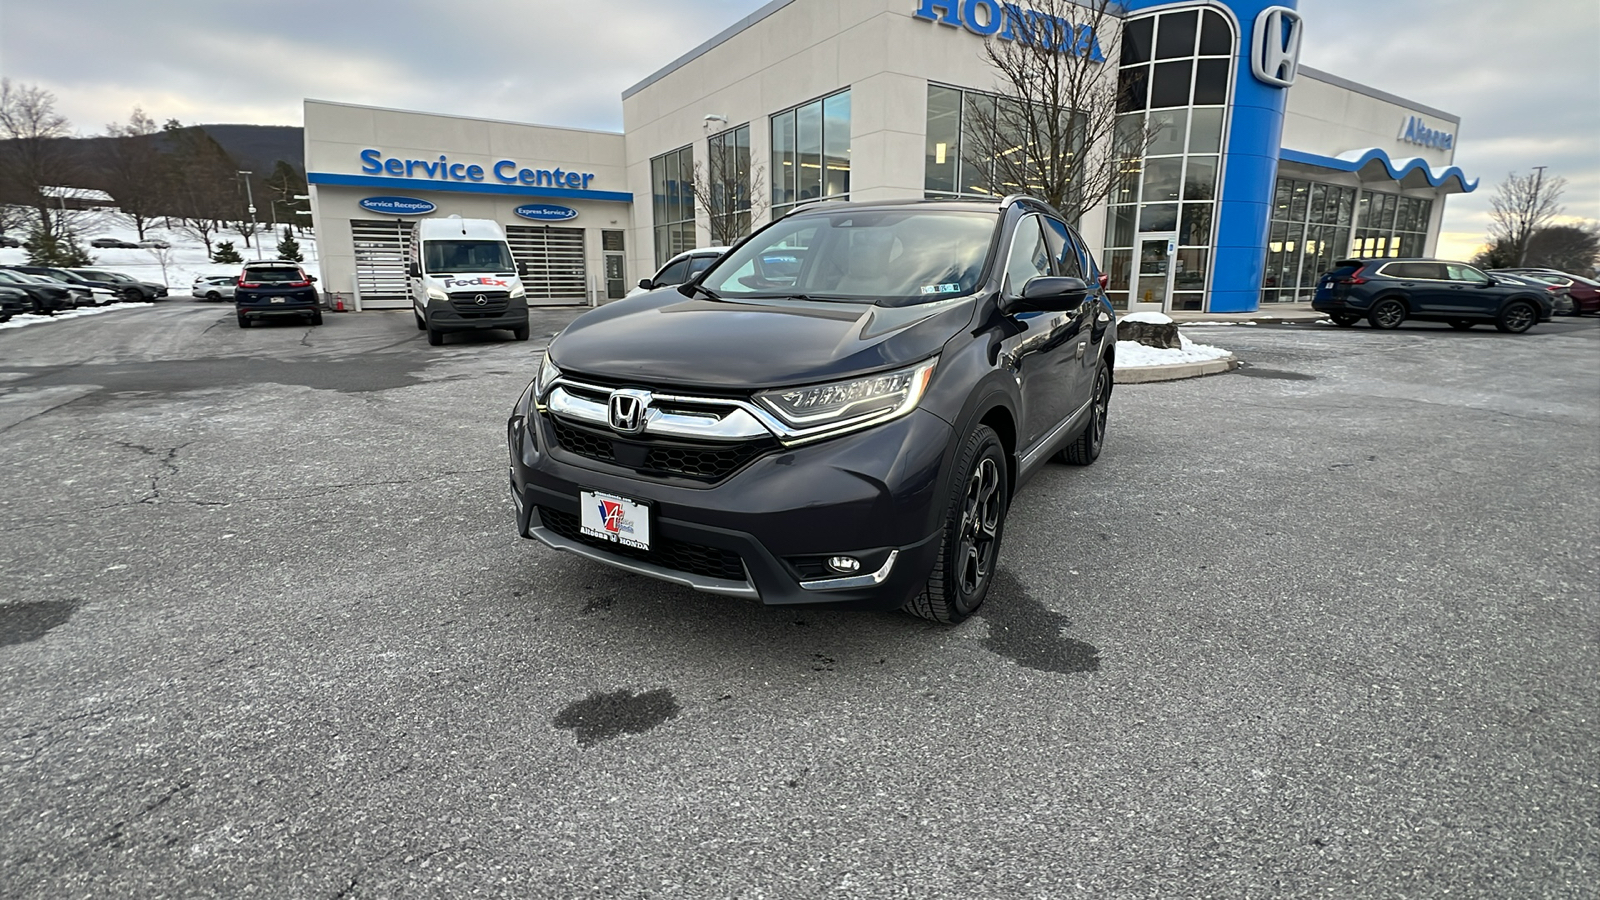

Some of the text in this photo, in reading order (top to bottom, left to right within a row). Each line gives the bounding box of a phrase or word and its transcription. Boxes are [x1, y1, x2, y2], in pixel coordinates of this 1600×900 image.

[913, 0, 1105, 62] HONDA
[360, 149, 595, 189] Service Center
[363, 200, 432, 210] Service Reception
[542, 208, 566, 216] Service
[444, 277, 509, 288] FedEx
[580, 527, 608, 540] Altoona
[619, 538, 649, 551] HONDA
